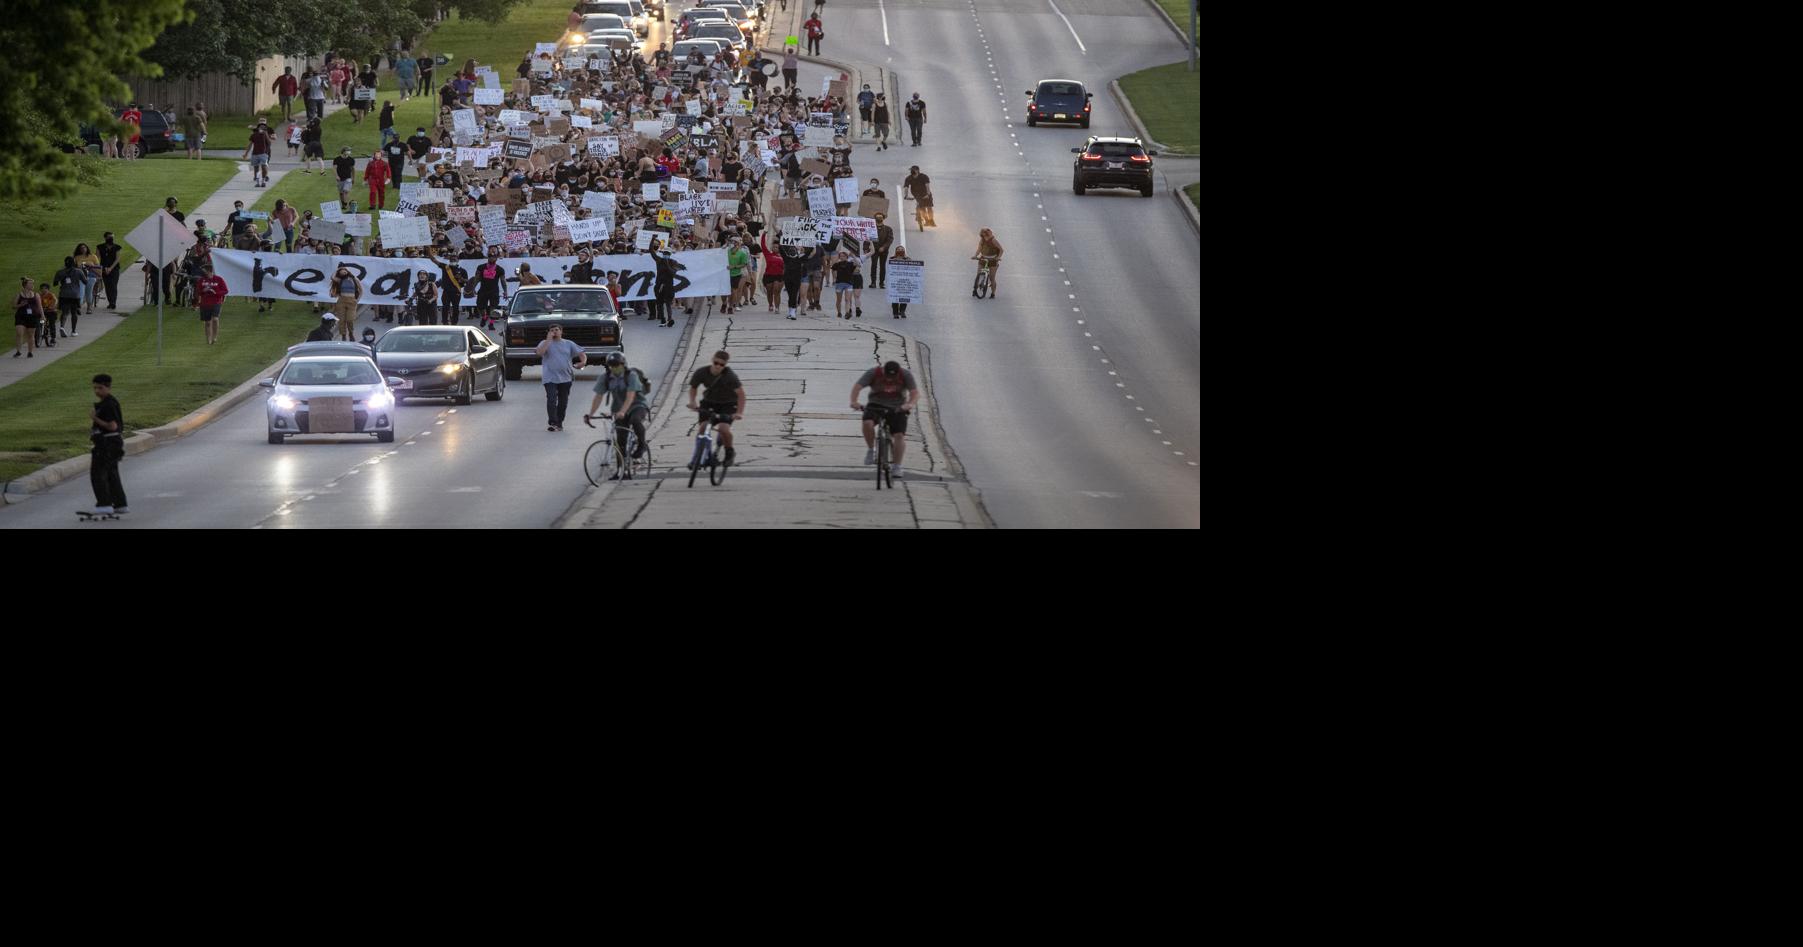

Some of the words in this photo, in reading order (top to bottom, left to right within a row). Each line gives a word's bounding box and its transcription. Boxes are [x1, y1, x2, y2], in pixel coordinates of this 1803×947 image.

[694, 138, 718, 148] BLM
[680, 193, 702, 201] BLACK
[571, 222, 589, 231] HANDS
[592, 219, 601, 227] UP
